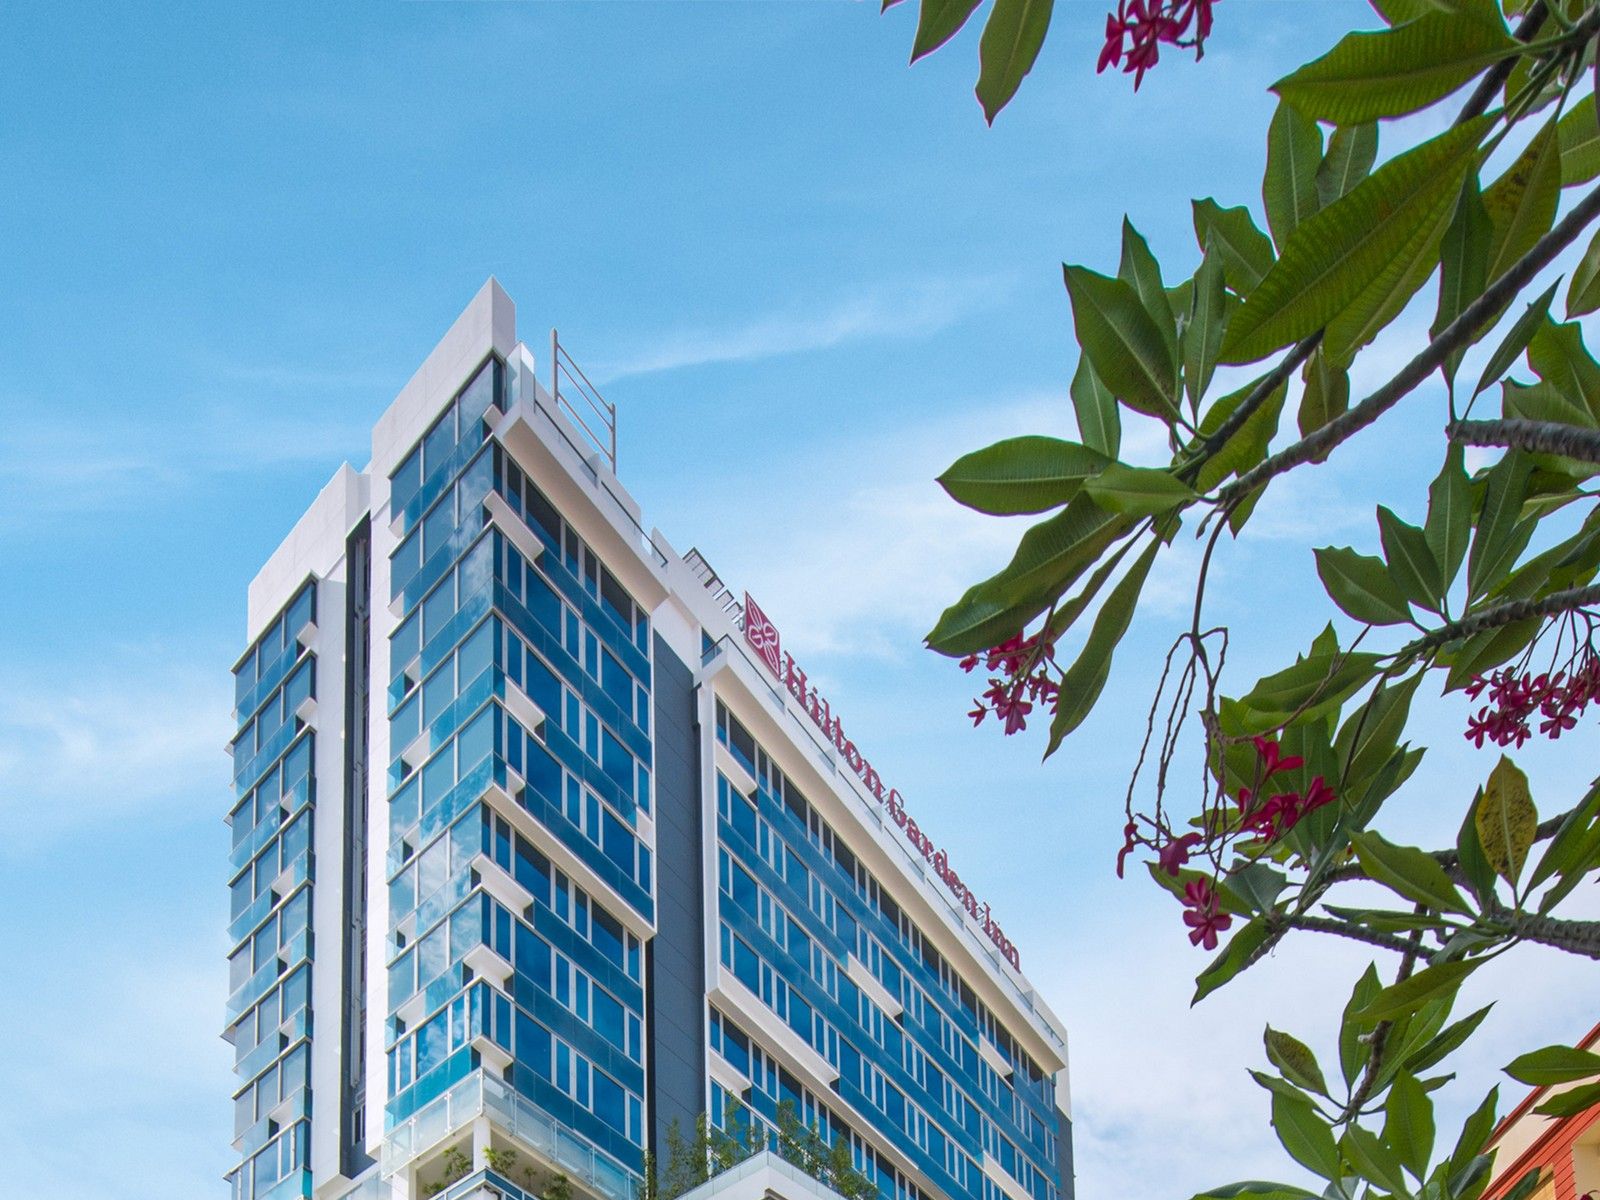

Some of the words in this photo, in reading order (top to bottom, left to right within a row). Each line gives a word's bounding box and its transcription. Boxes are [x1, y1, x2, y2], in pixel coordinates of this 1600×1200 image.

[784, 650, 886, 803] Hilton
[889, 788, 980, 920] Garden
[981, 901, 1021, 973] Inn
